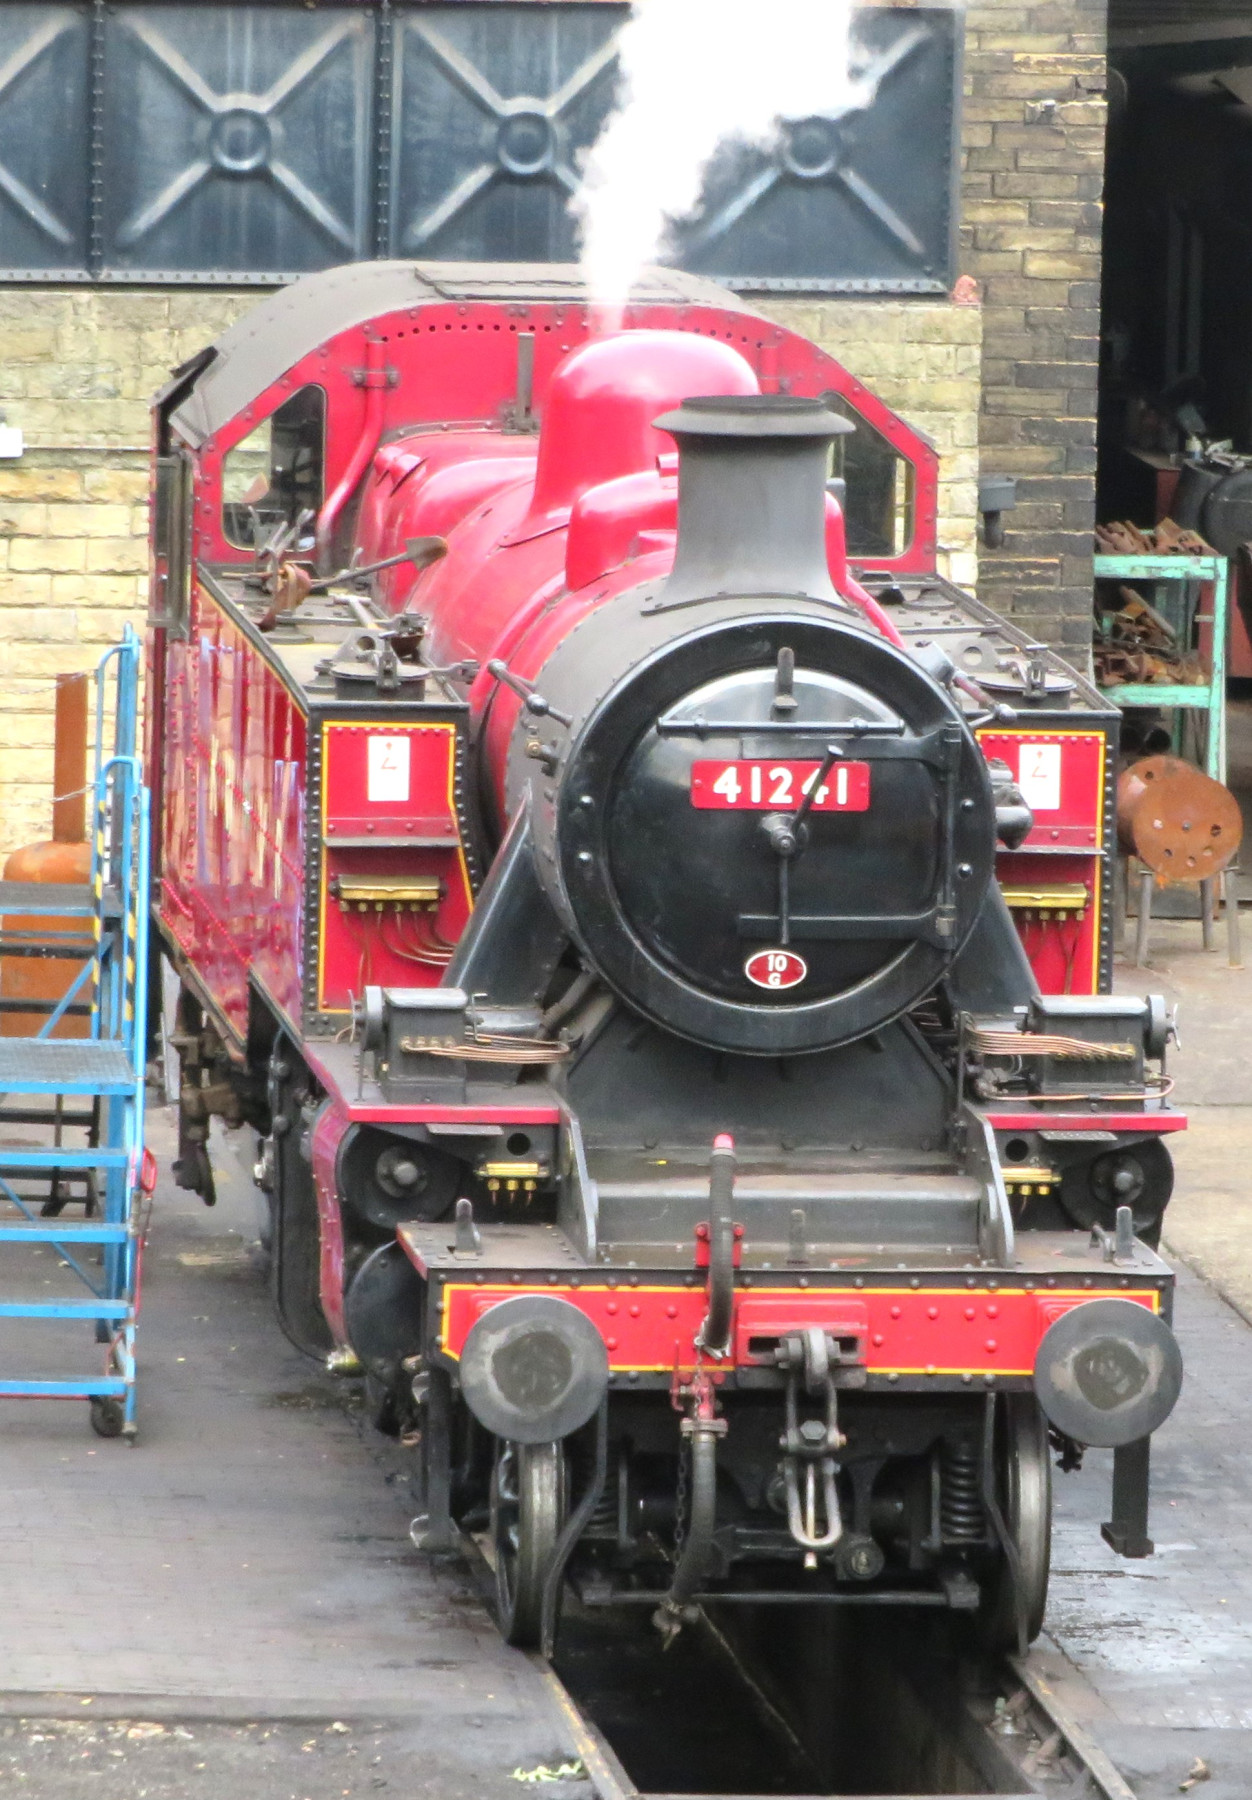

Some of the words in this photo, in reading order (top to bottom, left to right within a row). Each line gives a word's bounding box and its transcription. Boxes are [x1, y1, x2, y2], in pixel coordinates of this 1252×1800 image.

[713, 766, 848, 805] 41241
[767, 954, 788, 972] 10
[768, 972, 781, 986] G
